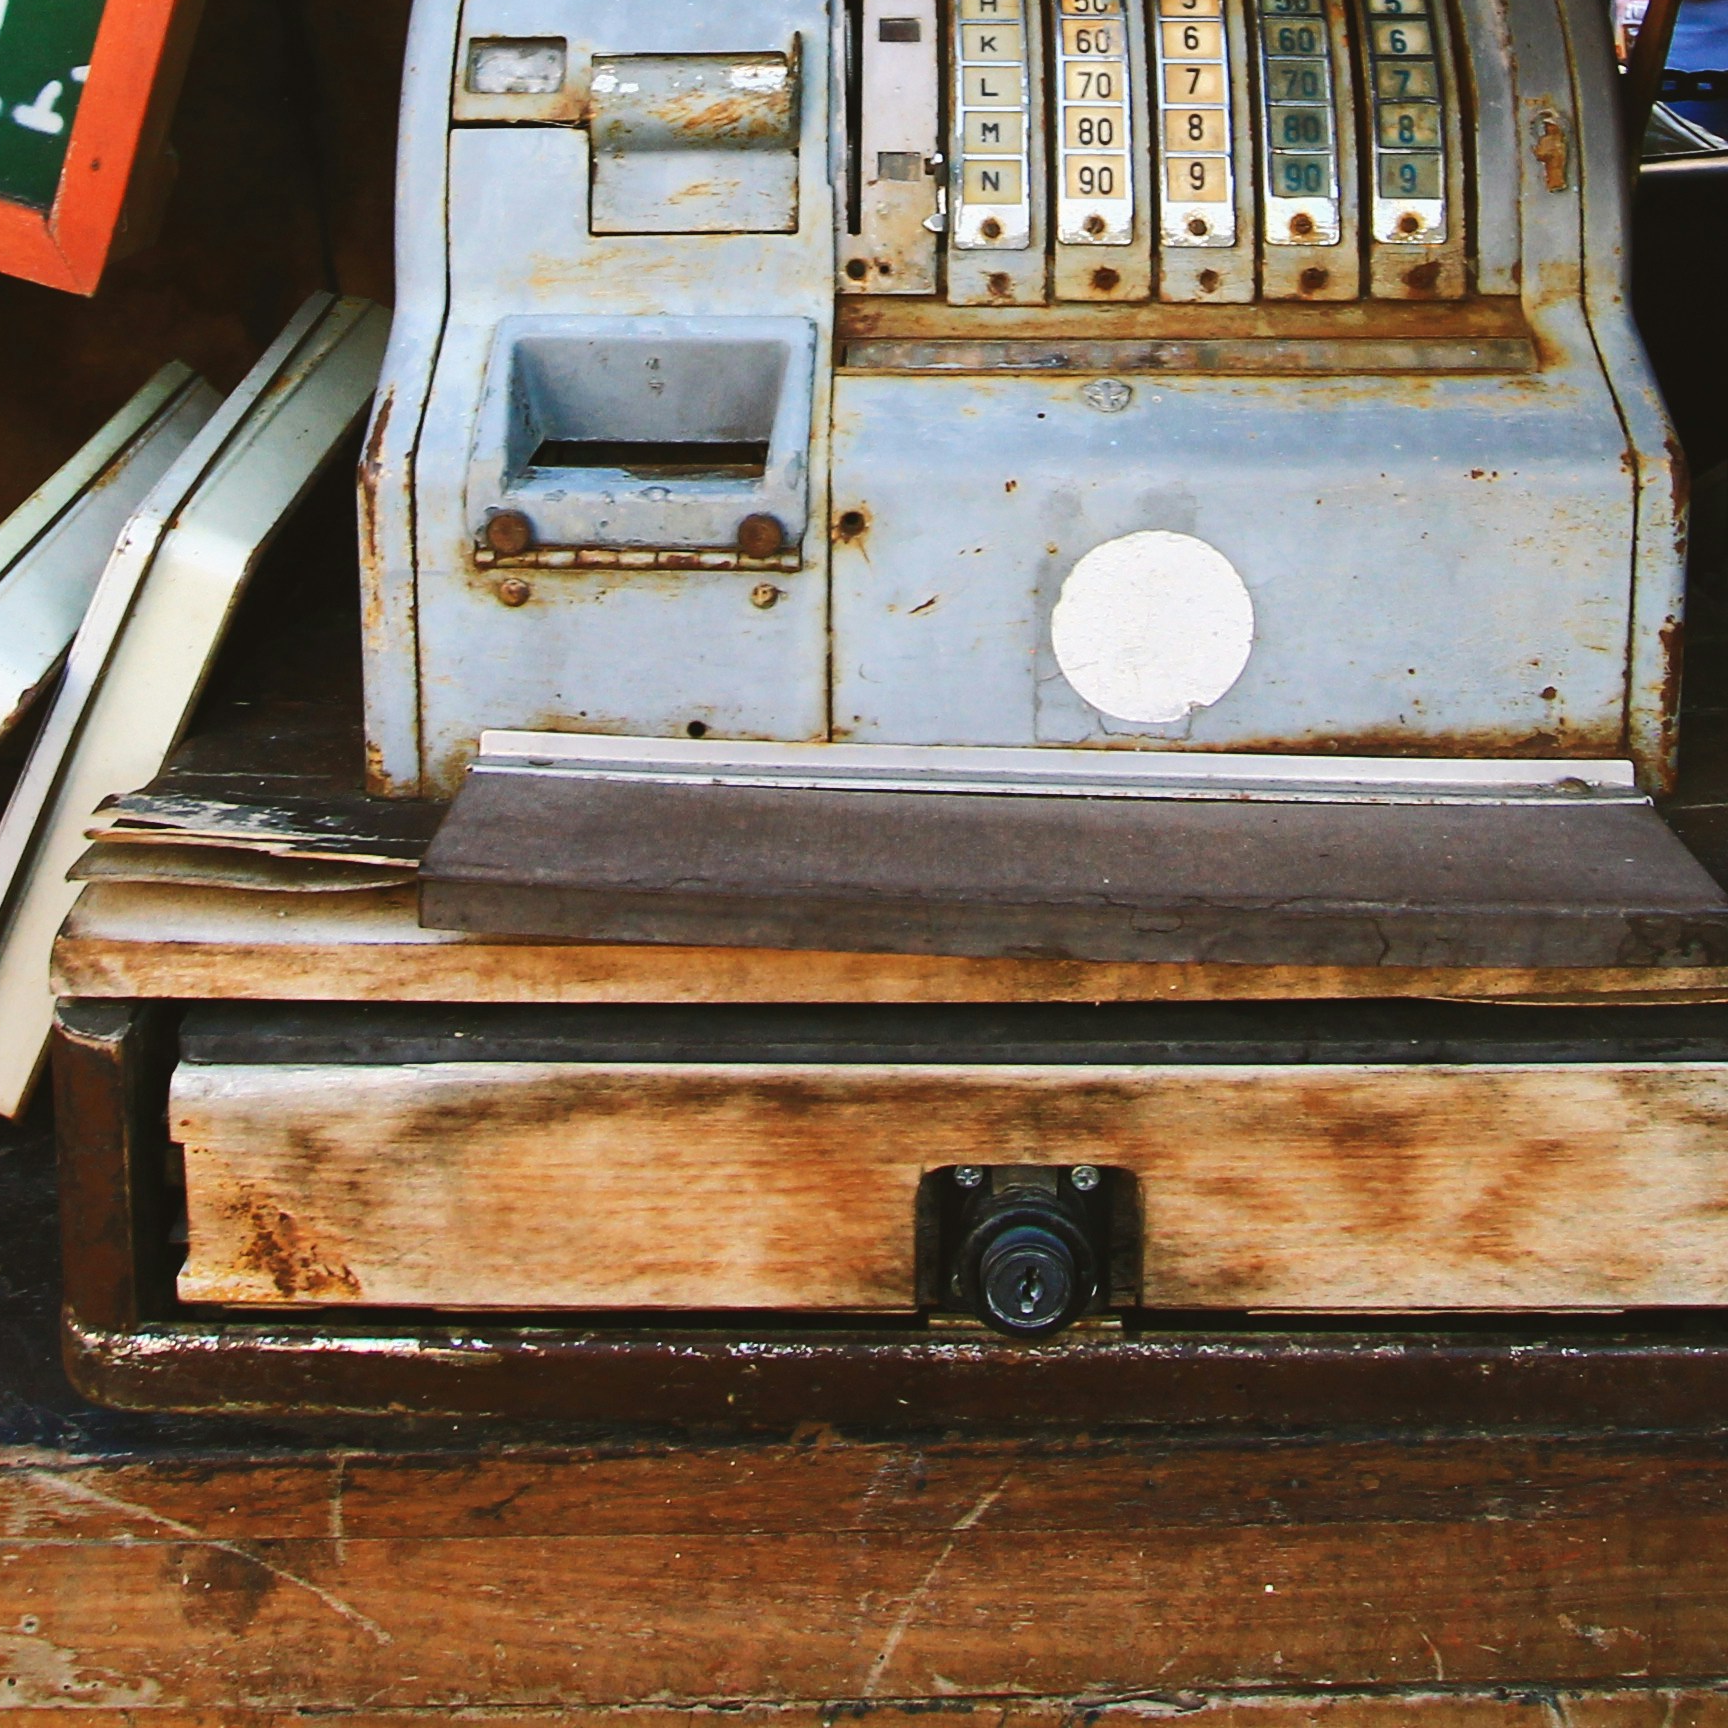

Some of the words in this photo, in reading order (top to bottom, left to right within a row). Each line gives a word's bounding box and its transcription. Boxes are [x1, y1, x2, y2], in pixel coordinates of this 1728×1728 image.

[980, 35, 997, 52] K
[1076, 29, 1110, 53] 60
[1183, 26, 1200, 50] 6
[1278, 27, 1315, 52] 60
[1390, 29, 1407, 53] 6
[980, 78, 999, 97] L
[1077, 72, 1112, 98] 70
[1185, 68, 1201, 94] 7
[1282, 71, 1318, 97] 70
[1393, 69, 1411, 96] 7
[981, 122, 1000, 142] M
[1078, 117, 1113, 145] 80
[1188, 114, 1204, 141] 8
[1283, 115, 1321, 143] 80
[1398, 115, 1415, 144] 8
[981, 171, 1000, 192] N
[1079, 166, 1114, 195] 90
[1189, 162, 1205, 190] 9
[1285, 163, 1322, 192] 90
[1399, 163, 1417, 193] 9
